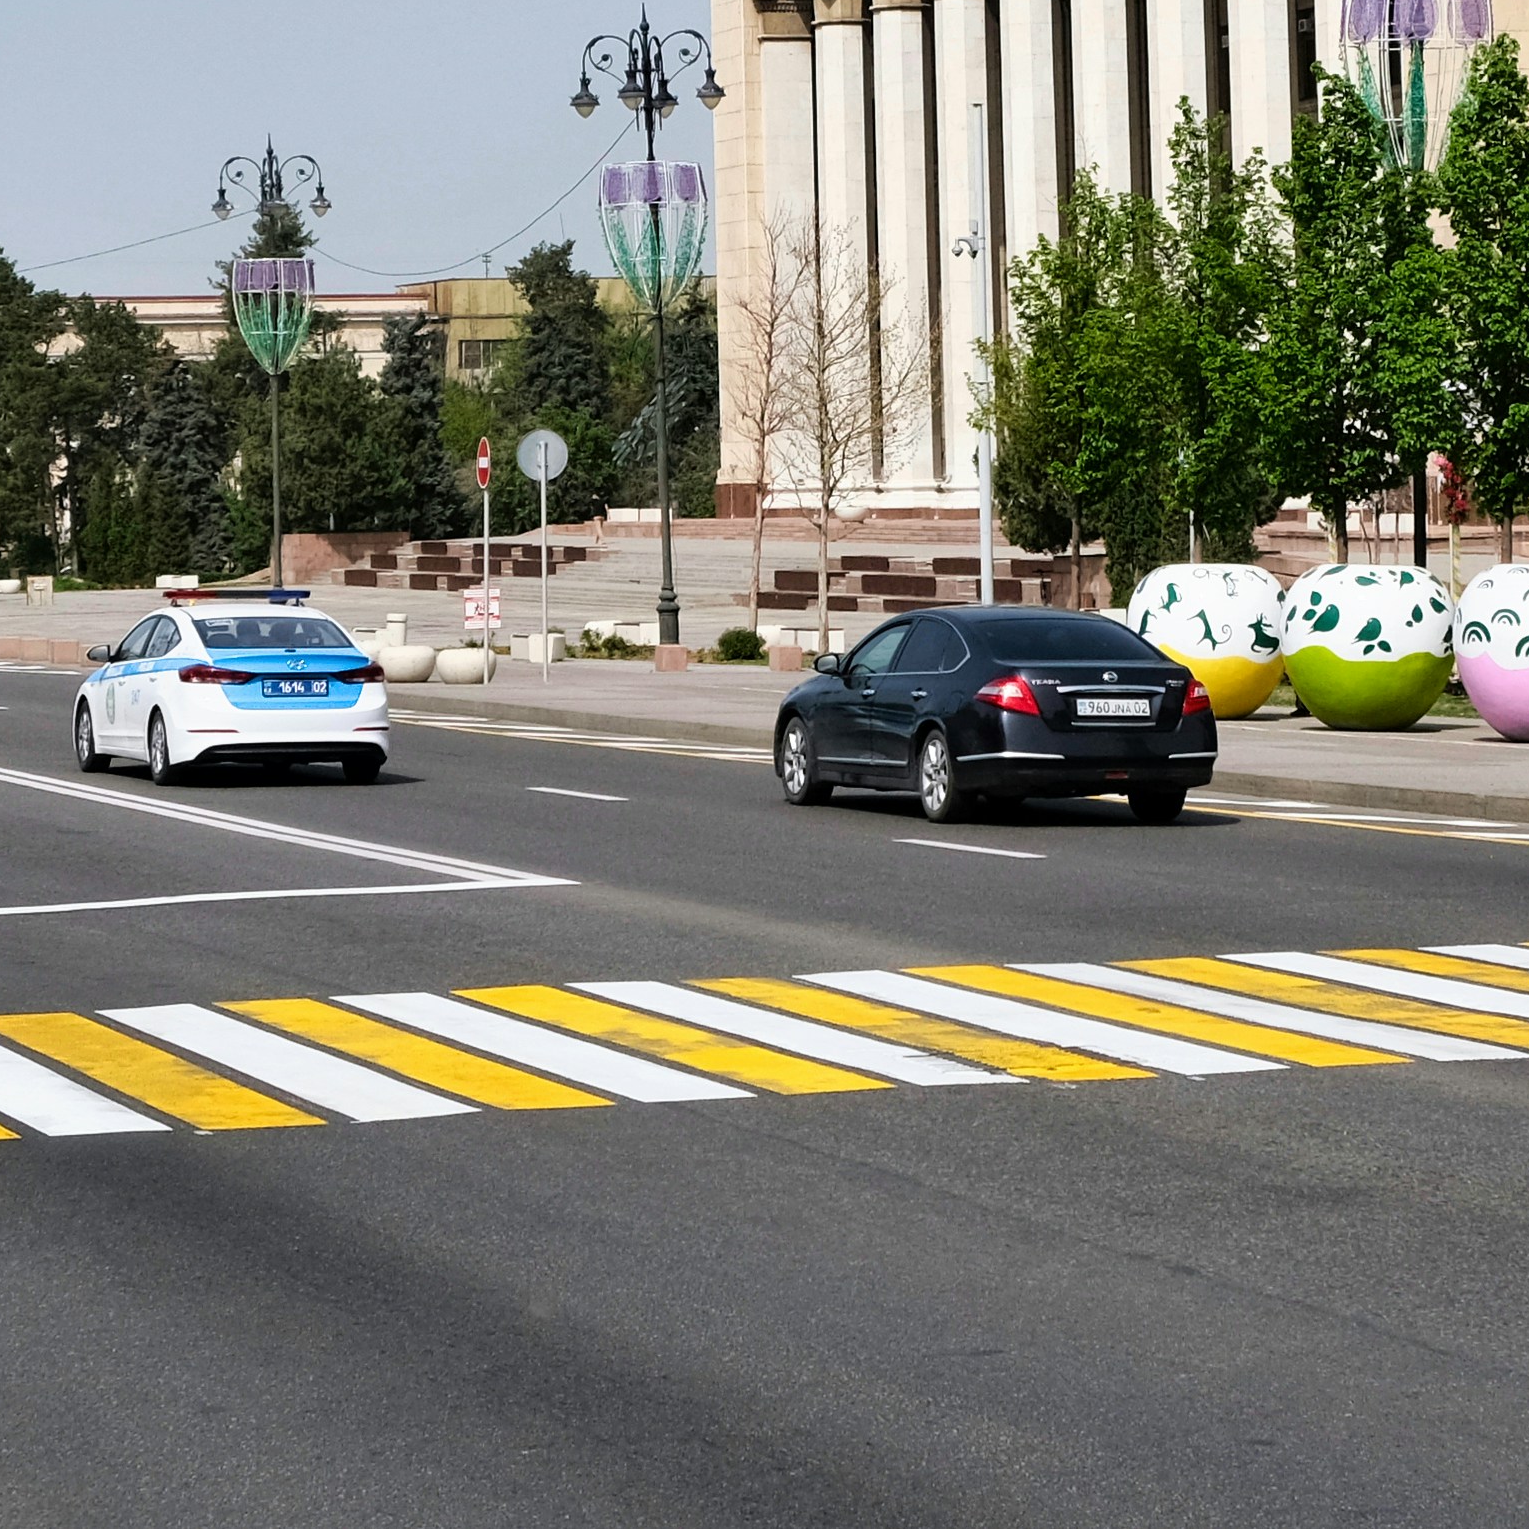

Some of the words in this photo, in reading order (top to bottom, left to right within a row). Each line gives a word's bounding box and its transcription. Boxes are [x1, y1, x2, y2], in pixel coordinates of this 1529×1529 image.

[278, 681, 305, 693] 1614
[313, 681, 328, 693] 02
[1088, 701, 1110, 714] 960
[1111, 703, 1132, 714] JNA
[1134, 702, 1148, 714] 02
